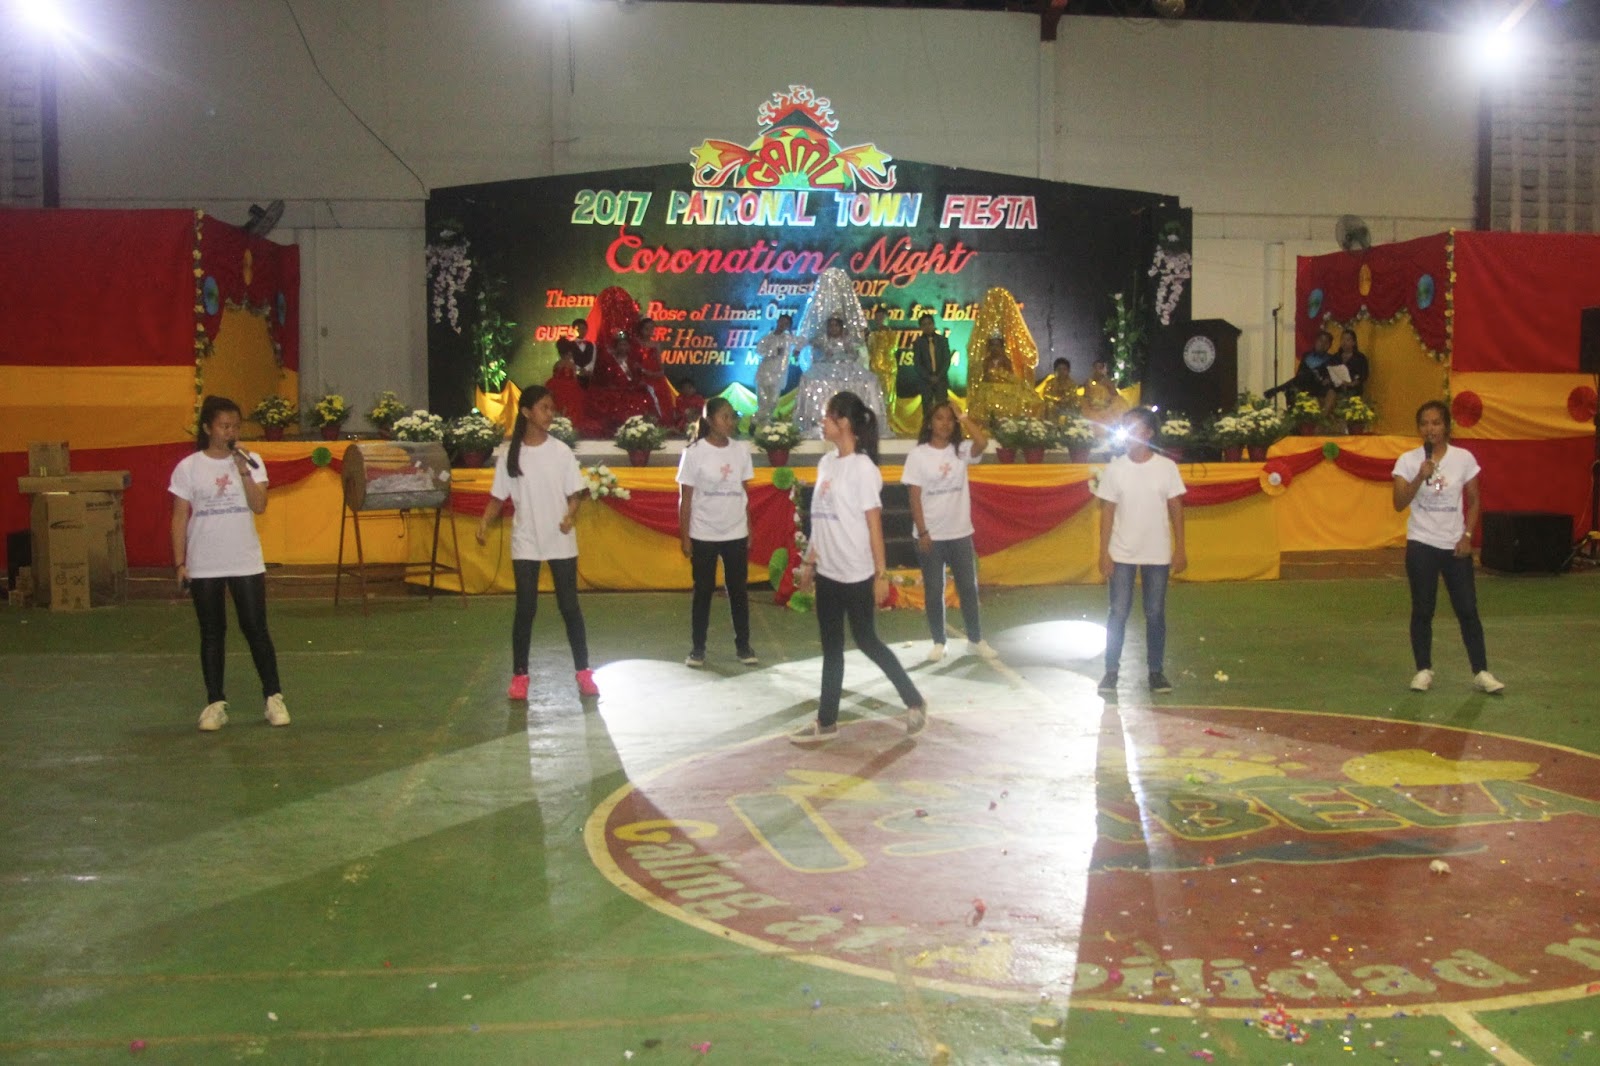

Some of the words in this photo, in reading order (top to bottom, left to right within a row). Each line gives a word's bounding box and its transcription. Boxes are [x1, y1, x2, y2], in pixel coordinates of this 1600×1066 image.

[571, 191, 652, 226] 2017
[665, 190, 818, 227] PATRONAL
[834, 190, 922, 228] TOWN
[940, 193, 1039, 229] FIESTA
[605, 225, 840, 276] Coronation
[849, 234, 978, 289] Night
[545, 289, 596, 308] Them
[647, 300, 688, 322] Rose
[690, 302, 711, 322] of
[709, 302, 762, 322] Lima:
[673, 327, 718, 349] Hon.
